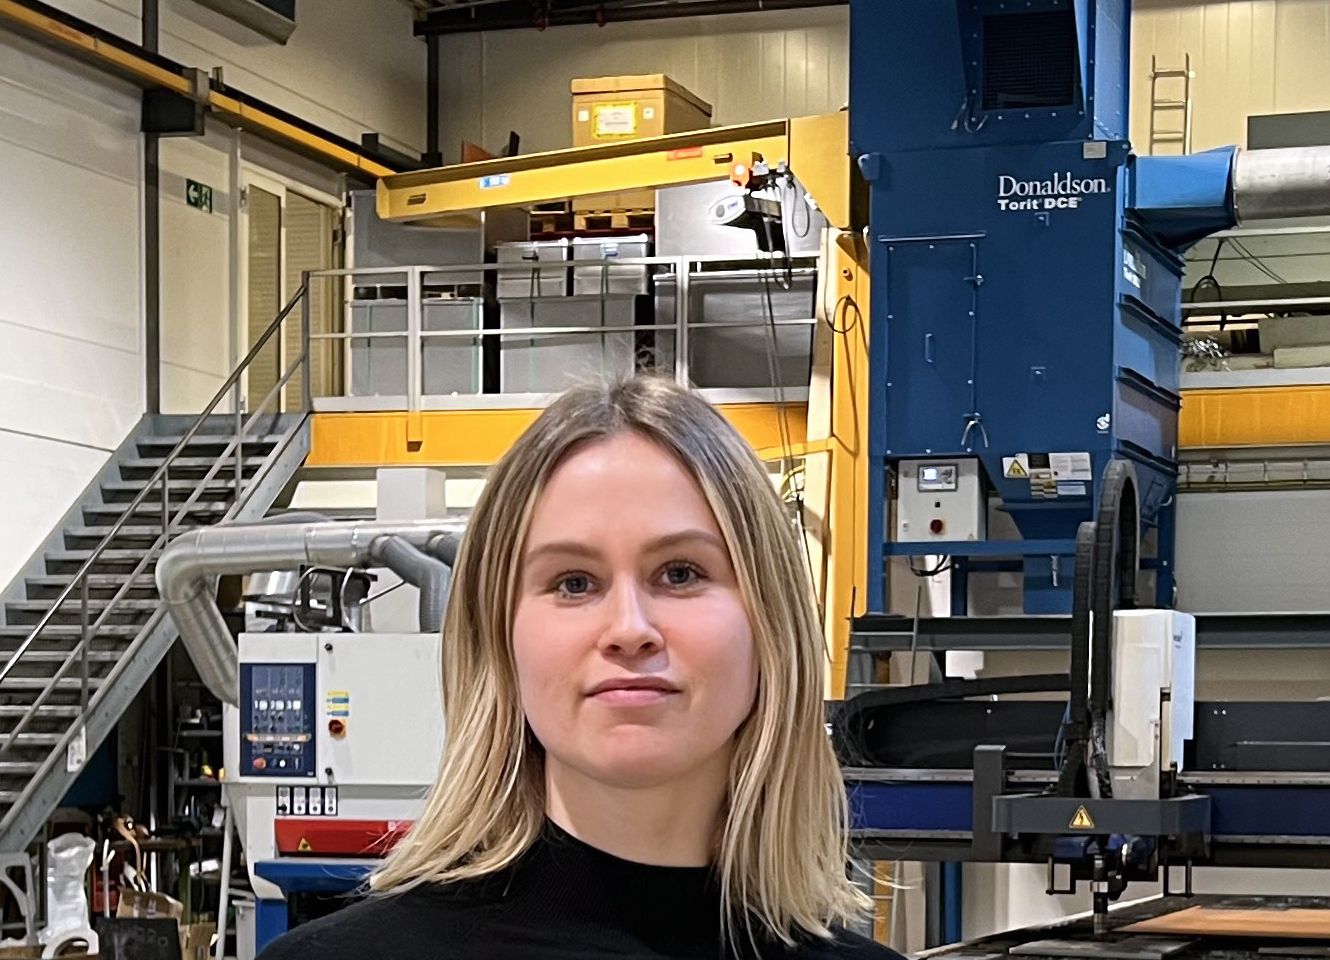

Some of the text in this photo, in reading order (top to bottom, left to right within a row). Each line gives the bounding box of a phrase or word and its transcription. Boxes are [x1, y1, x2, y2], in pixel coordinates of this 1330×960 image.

[998, 172, 1106, 197] Donaldson
[998, 197, 1078, 211] Torit DCE
